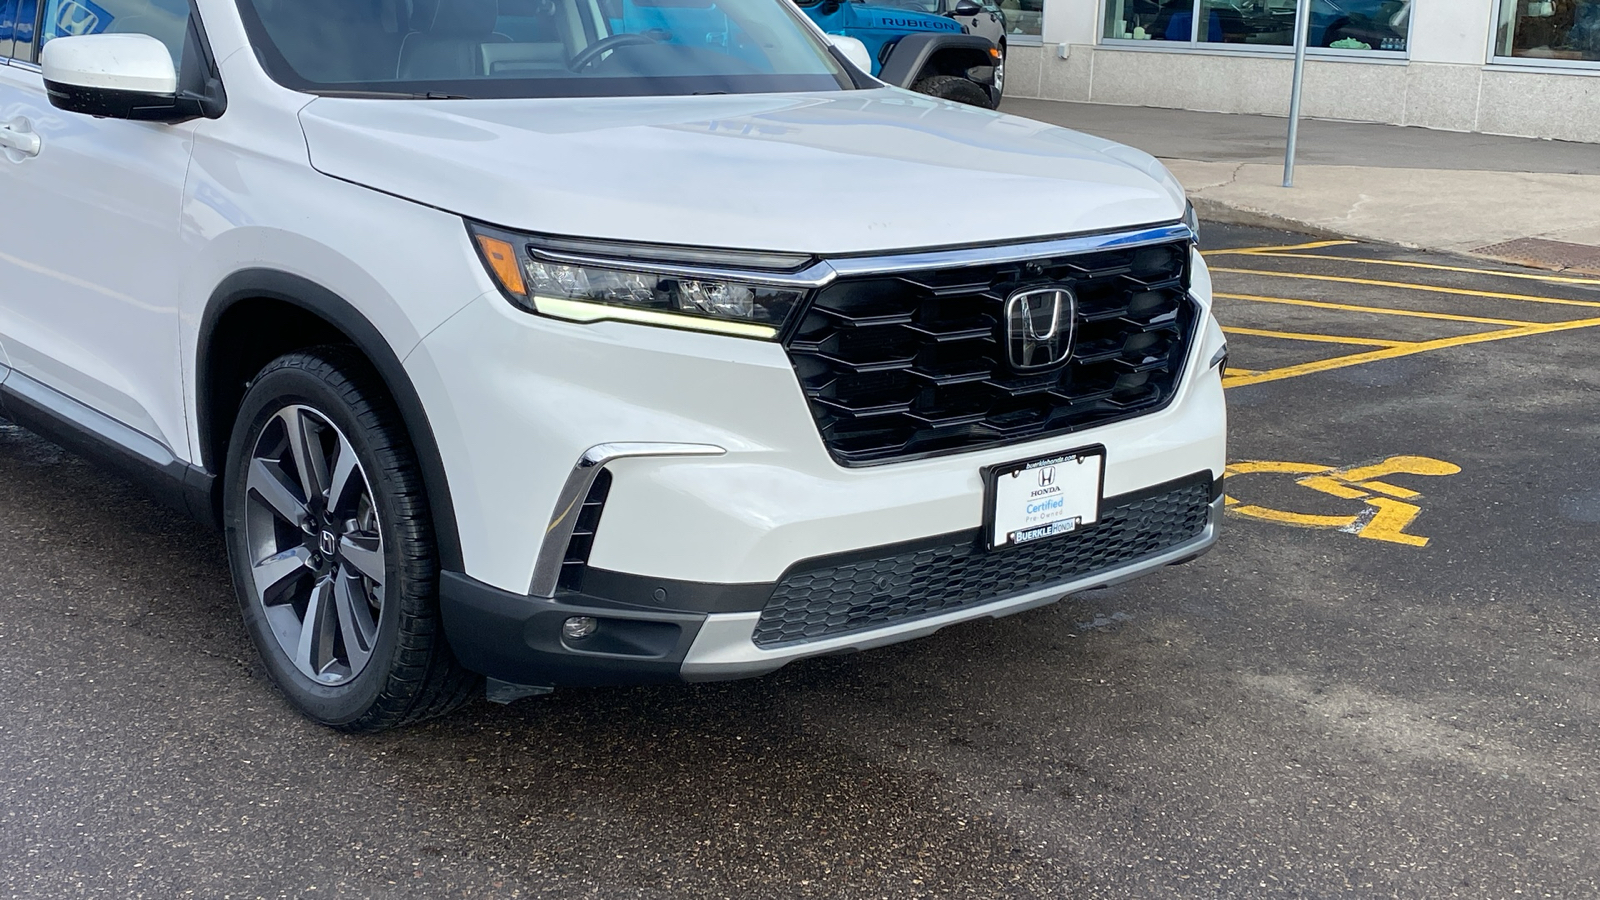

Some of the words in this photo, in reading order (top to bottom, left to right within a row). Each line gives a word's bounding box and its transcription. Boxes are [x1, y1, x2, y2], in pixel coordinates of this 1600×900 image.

[882, 17, 954, 31] RUBICON
[1026, 454, 1076, 470] buerklehonda.com
[1031, 485, 1061, 497] HONDA
[1026, 496, 1063, 514] Certified
[1025, 509, 1062, 523] Pre-Owned
